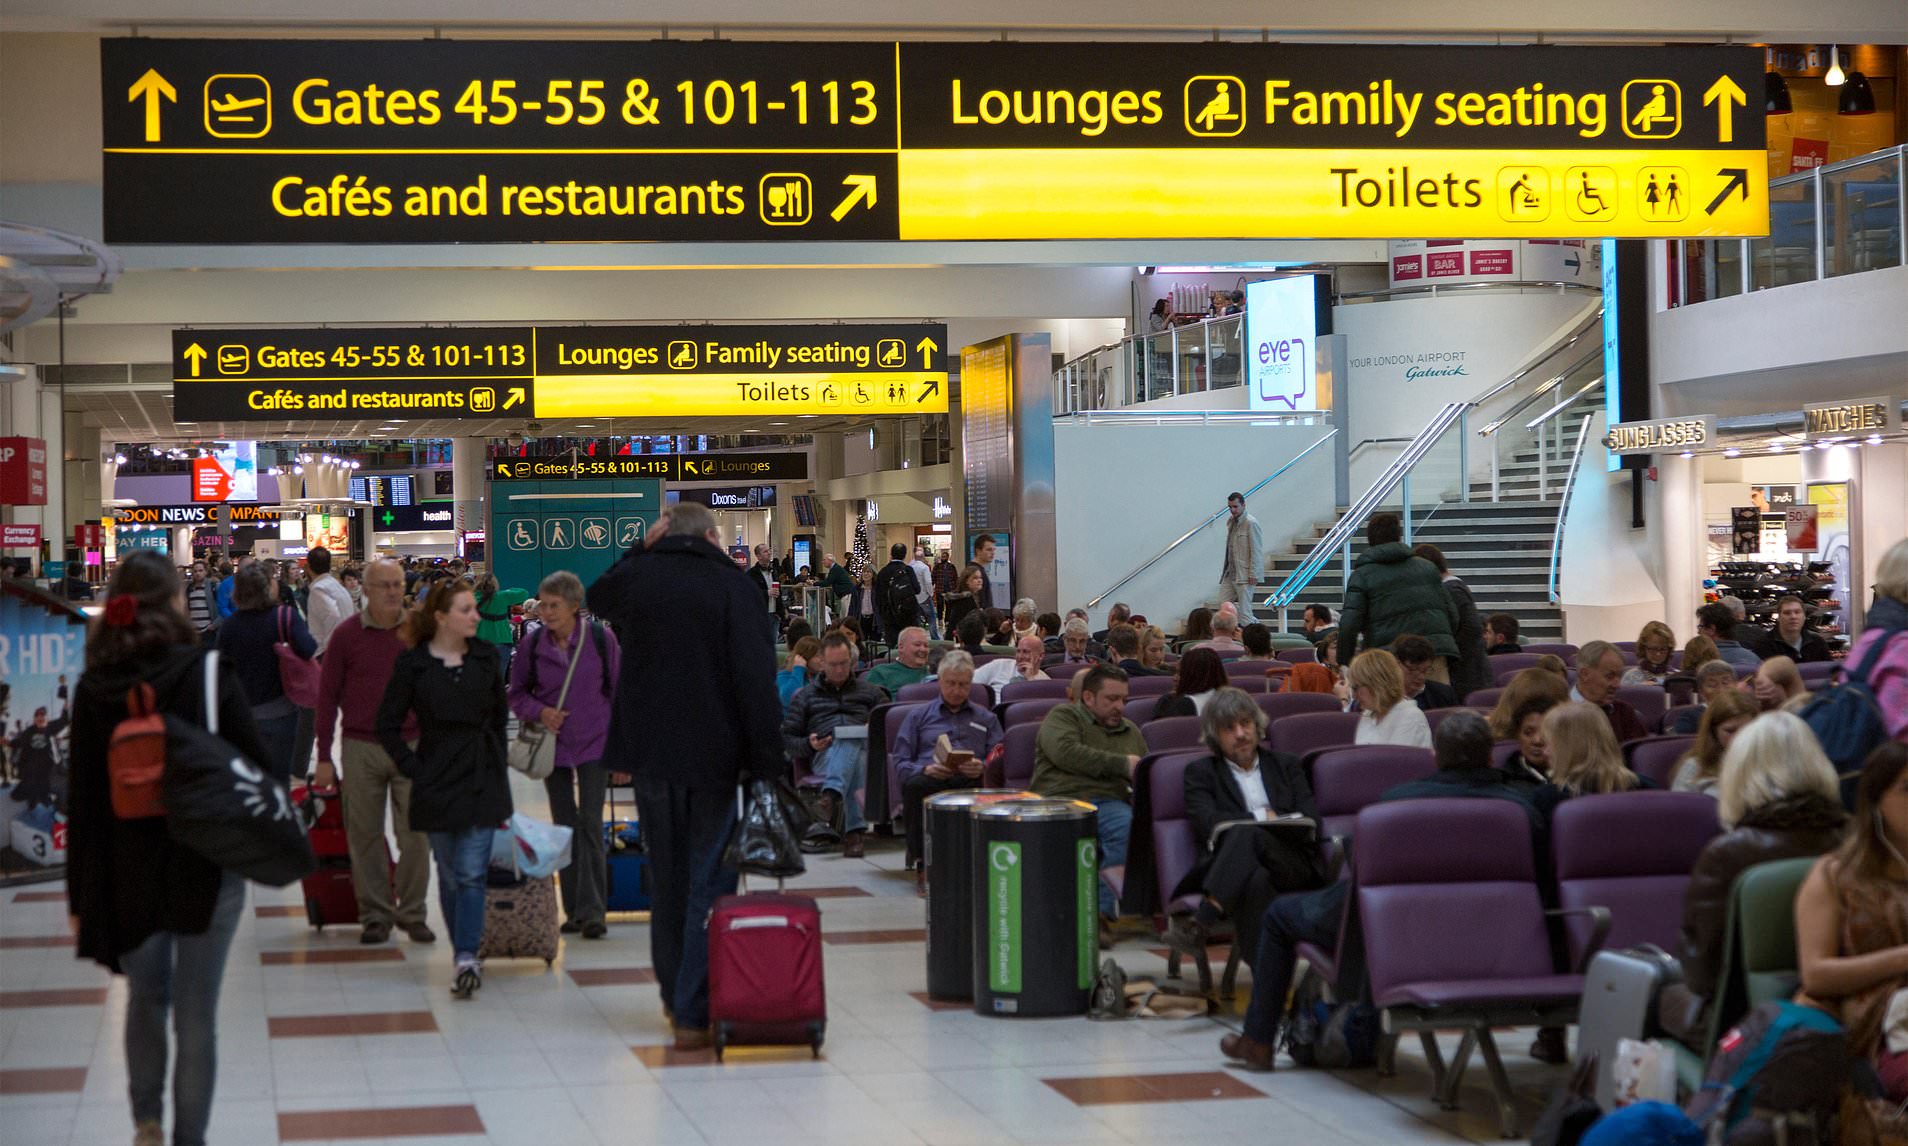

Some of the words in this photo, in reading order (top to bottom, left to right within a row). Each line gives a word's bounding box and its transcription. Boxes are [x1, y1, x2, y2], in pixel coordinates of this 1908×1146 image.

[293, 78, 441, 126] Gates
[455, 79, 606, 126] 45-55
[621, 78, 661, 126] &
[677, 79, 878, 126] 101-113
[953, 79, 1163, 137] Lounges
[1265, 79, 1424, 138] Family
[1434, 82, 1607, 138] seating
[271, 174, 393, 217] Cafés
[404, 174, 488, 217] and
[501, 180, 745, 216] restaurants
[1330, 167, 1481, 208] Toilets
[1434, 259, 1456, 269] BAR
[257, 345, 326, 368] Gates
[331, 345, 401, 368] 45-55
[407, 344, 425, 367] &
[431, 344, 526, 367] 101-113
[558, 343, 659, 370] Lounges
[705, 341, 783, 370] Family
[786, 342, 870, 370] seating
[1258, 338, 1290, 364] eye
[1350, 358, 1372, 368] YOUR
[1373, 354, 1414, 366] LONDON
[1417, 351, 1466, 363] AIRPORT
[1406, 364, 1470, 382] Gatwick
[247, 389, 304, 410] Cafés
[307, 389, 347, 409] and
[351, 389, 465, 409] restaurants
[737, 382, 810, 402] Toilets
[1805, 404, 1888, 431] WATCHES
[1607, 420, 1706, 450] SUNGLASSES
[534, 462, 568, 475] Gates
[607, 461, 618, 474] &
[620, 461, 669, 474] 101-113
[721, 460, 771, 475] Lounges
[162, 507, 206, 522] NEWS
[207, 506, 280, 521] CMPAN
[423, 511, 451, 522] health
[3, 535, 37, 546] Exchange
[4, 526, 36, 537] Currency
